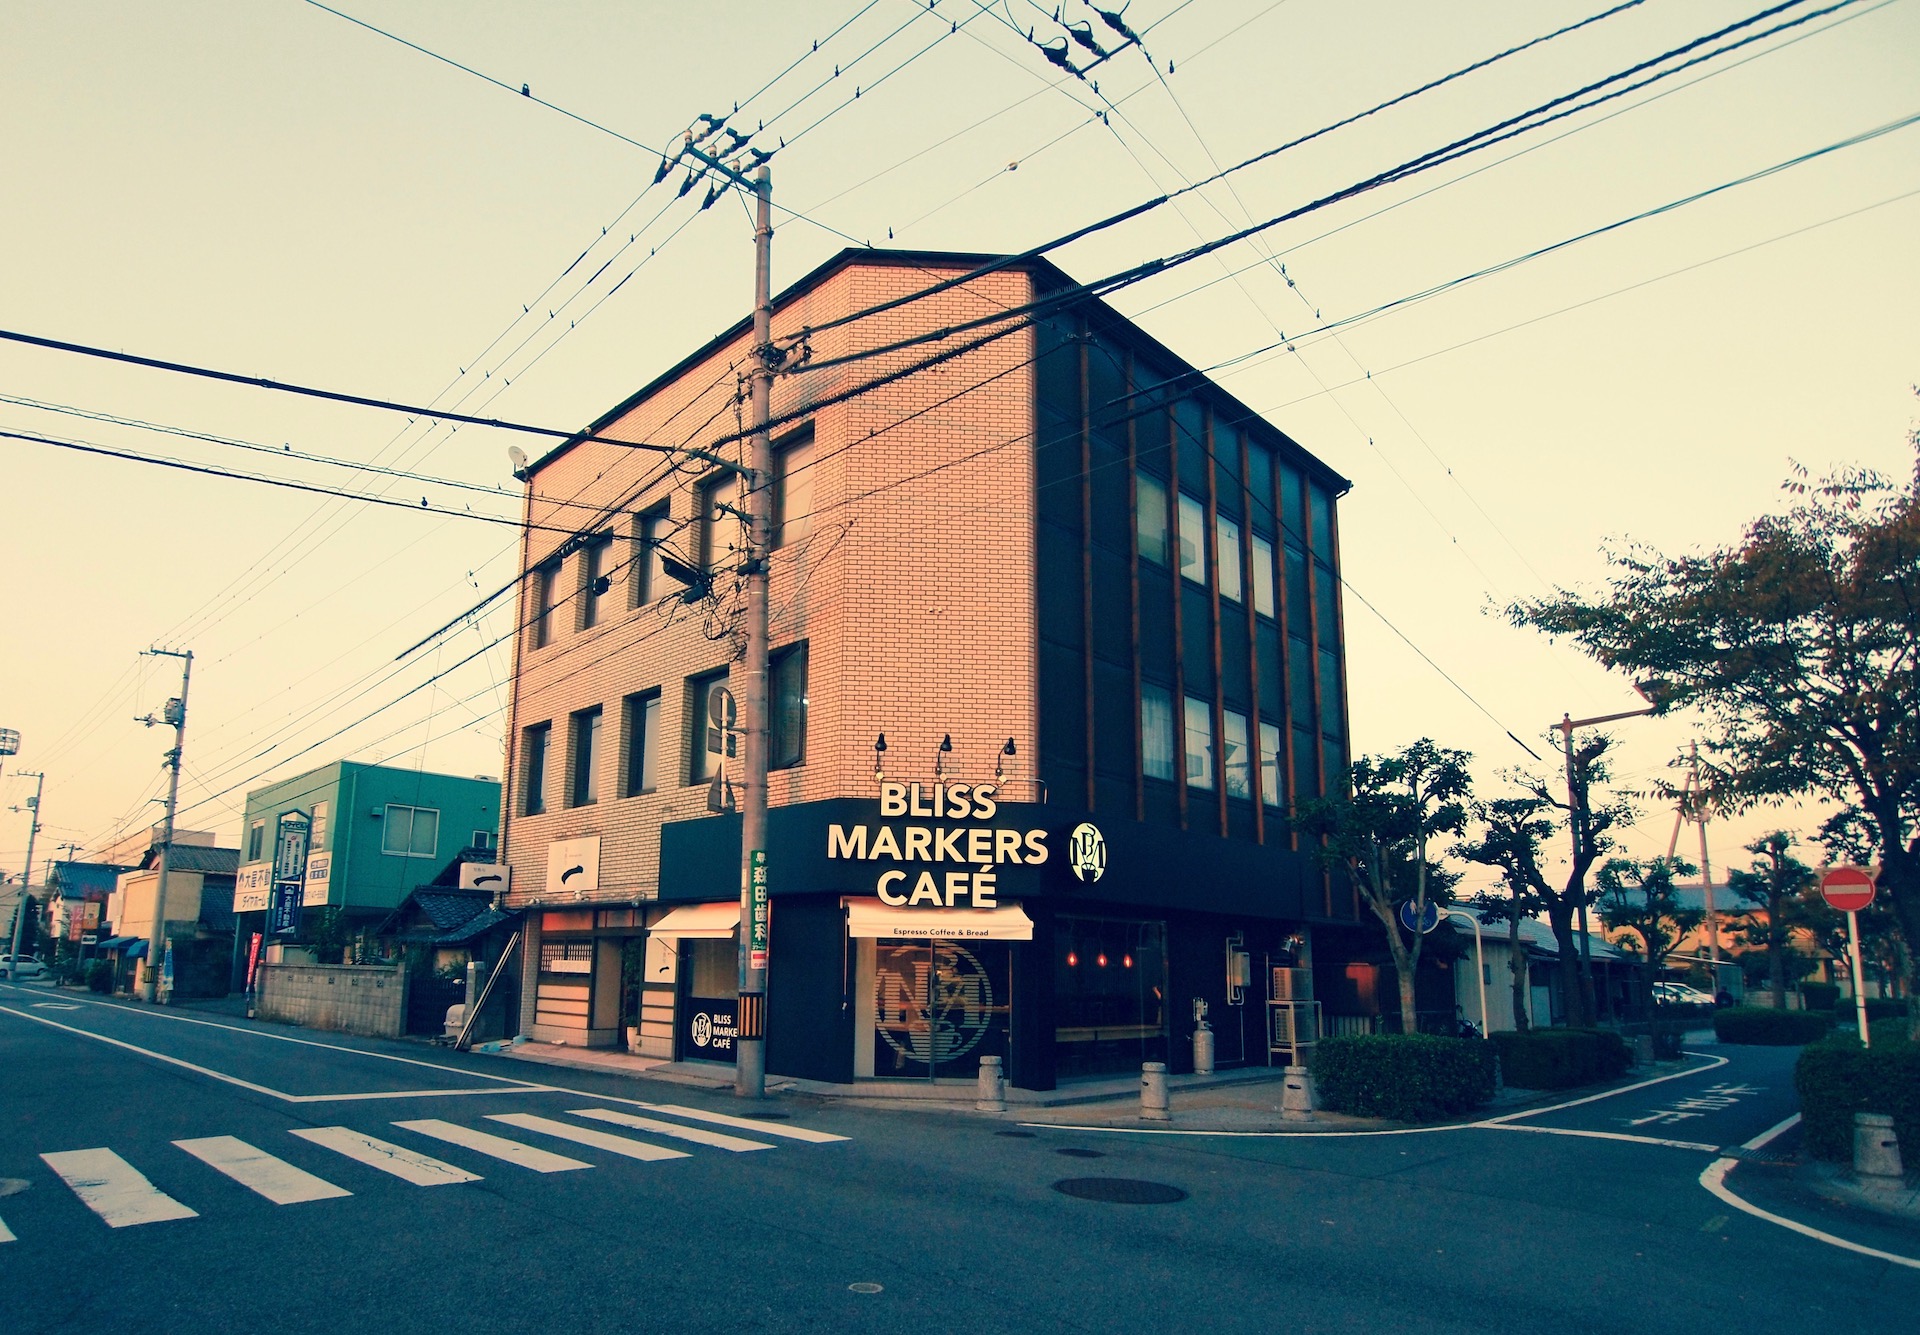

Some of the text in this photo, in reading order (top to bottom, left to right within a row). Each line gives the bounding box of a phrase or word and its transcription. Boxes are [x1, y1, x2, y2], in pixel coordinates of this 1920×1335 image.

[880, 782, 998, 819] BLISS
[827, 824, 1050, 864] MARKERS
[876, 865, 998, 908] CAFÉ
[894, 928, 928, 936] Espresso
[930, 928, 956, 936] Coffee
[713, 1014, 732, 1025] BLISS
[712, 1037, 731, 1049] CAFÉ
